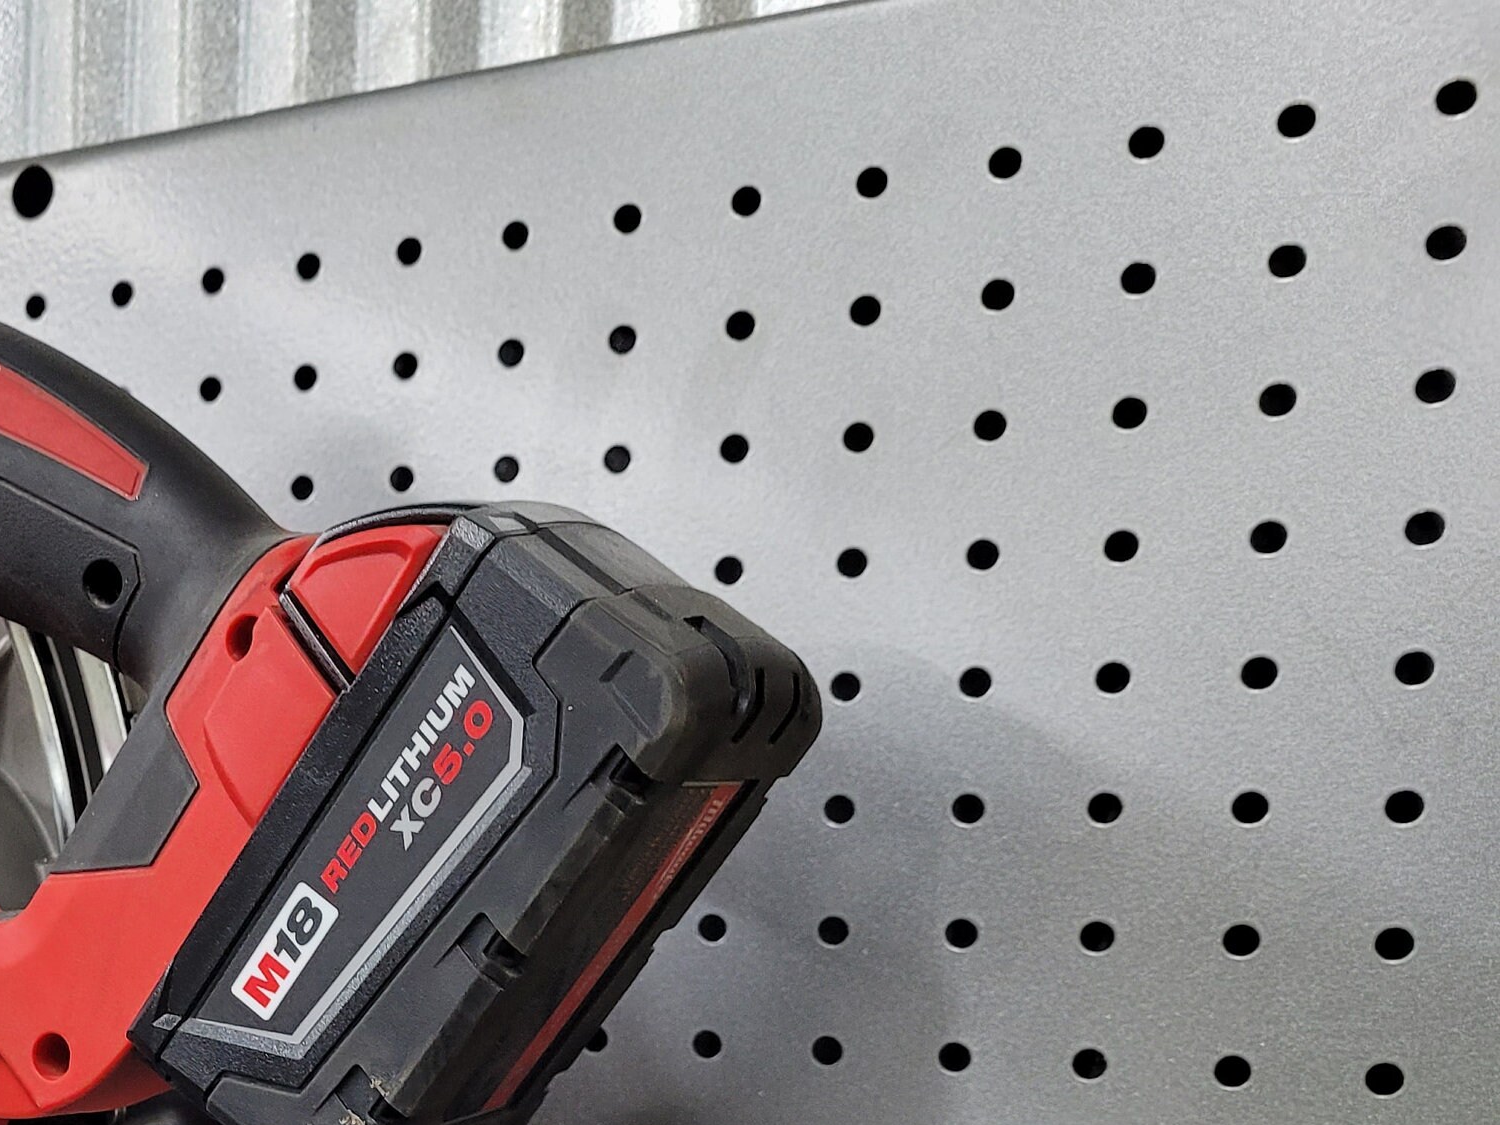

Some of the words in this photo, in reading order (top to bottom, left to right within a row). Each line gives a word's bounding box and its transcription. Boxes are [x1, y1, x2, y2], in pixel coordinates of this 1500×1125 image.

[320, 664, 476, 892] REDLITHIUM
[390, 700, 494, 851] XC5.0
[242, 897, 323, 1009] M18
